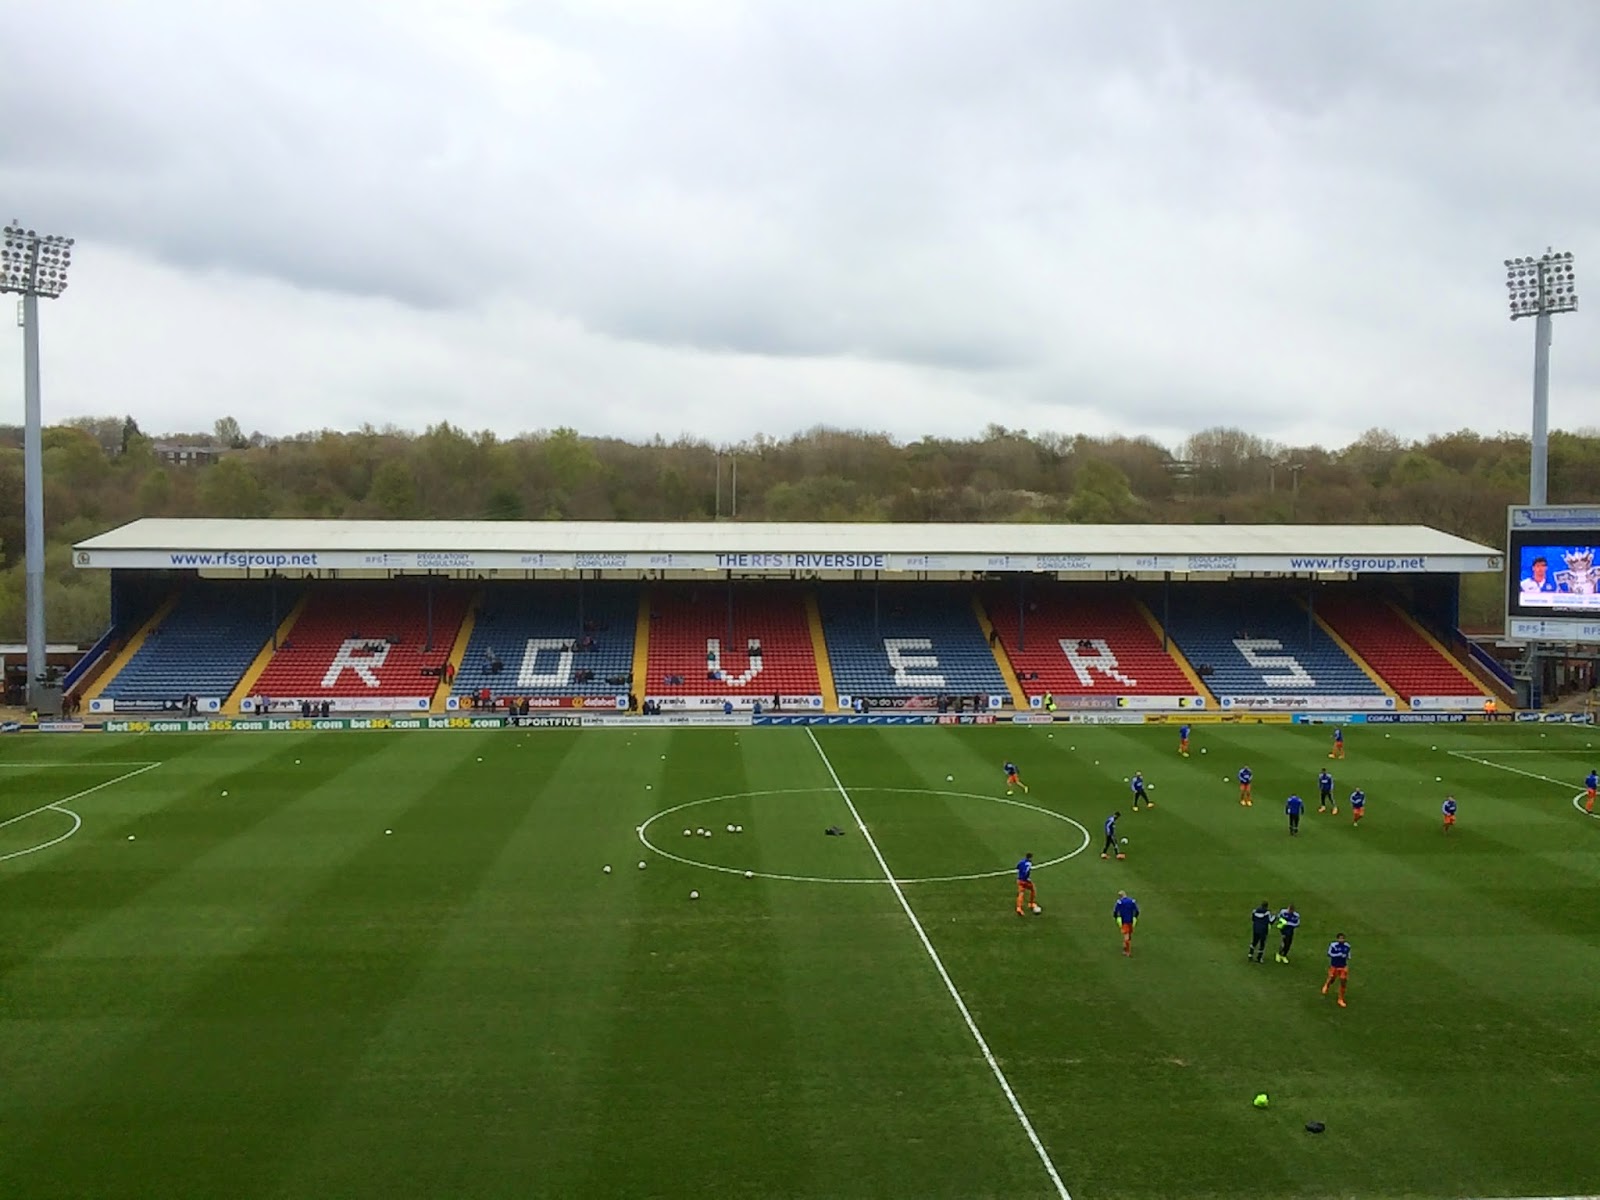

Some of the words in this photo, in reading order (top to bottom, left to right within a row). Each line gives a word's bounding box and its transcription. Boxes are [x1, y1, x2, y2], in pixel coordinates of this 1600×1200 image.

[170, 552, 318, 567] www.rfsgroup.net
[716, 554, 747, 567] THE
[752, 554, 783, 566] RFS
[795, 554, 883, 567] RIVERSIDE
[1290, 556, 1425, 570] www.rfsgroup.net
[1518, 624, 1539, 633] RFS
[351, 719, 420, 729] bet365.com
[428, 718, 500, 728] bet365.com
[519, 717, 580, 726] SPORTFIVE
[1367, 715, 1394, 723] CORAL
[108, 722, 181, 732] bet365.com
[188, 721, 262, 731] bet365.com
[269, 720, 343, 730] bet365.com
